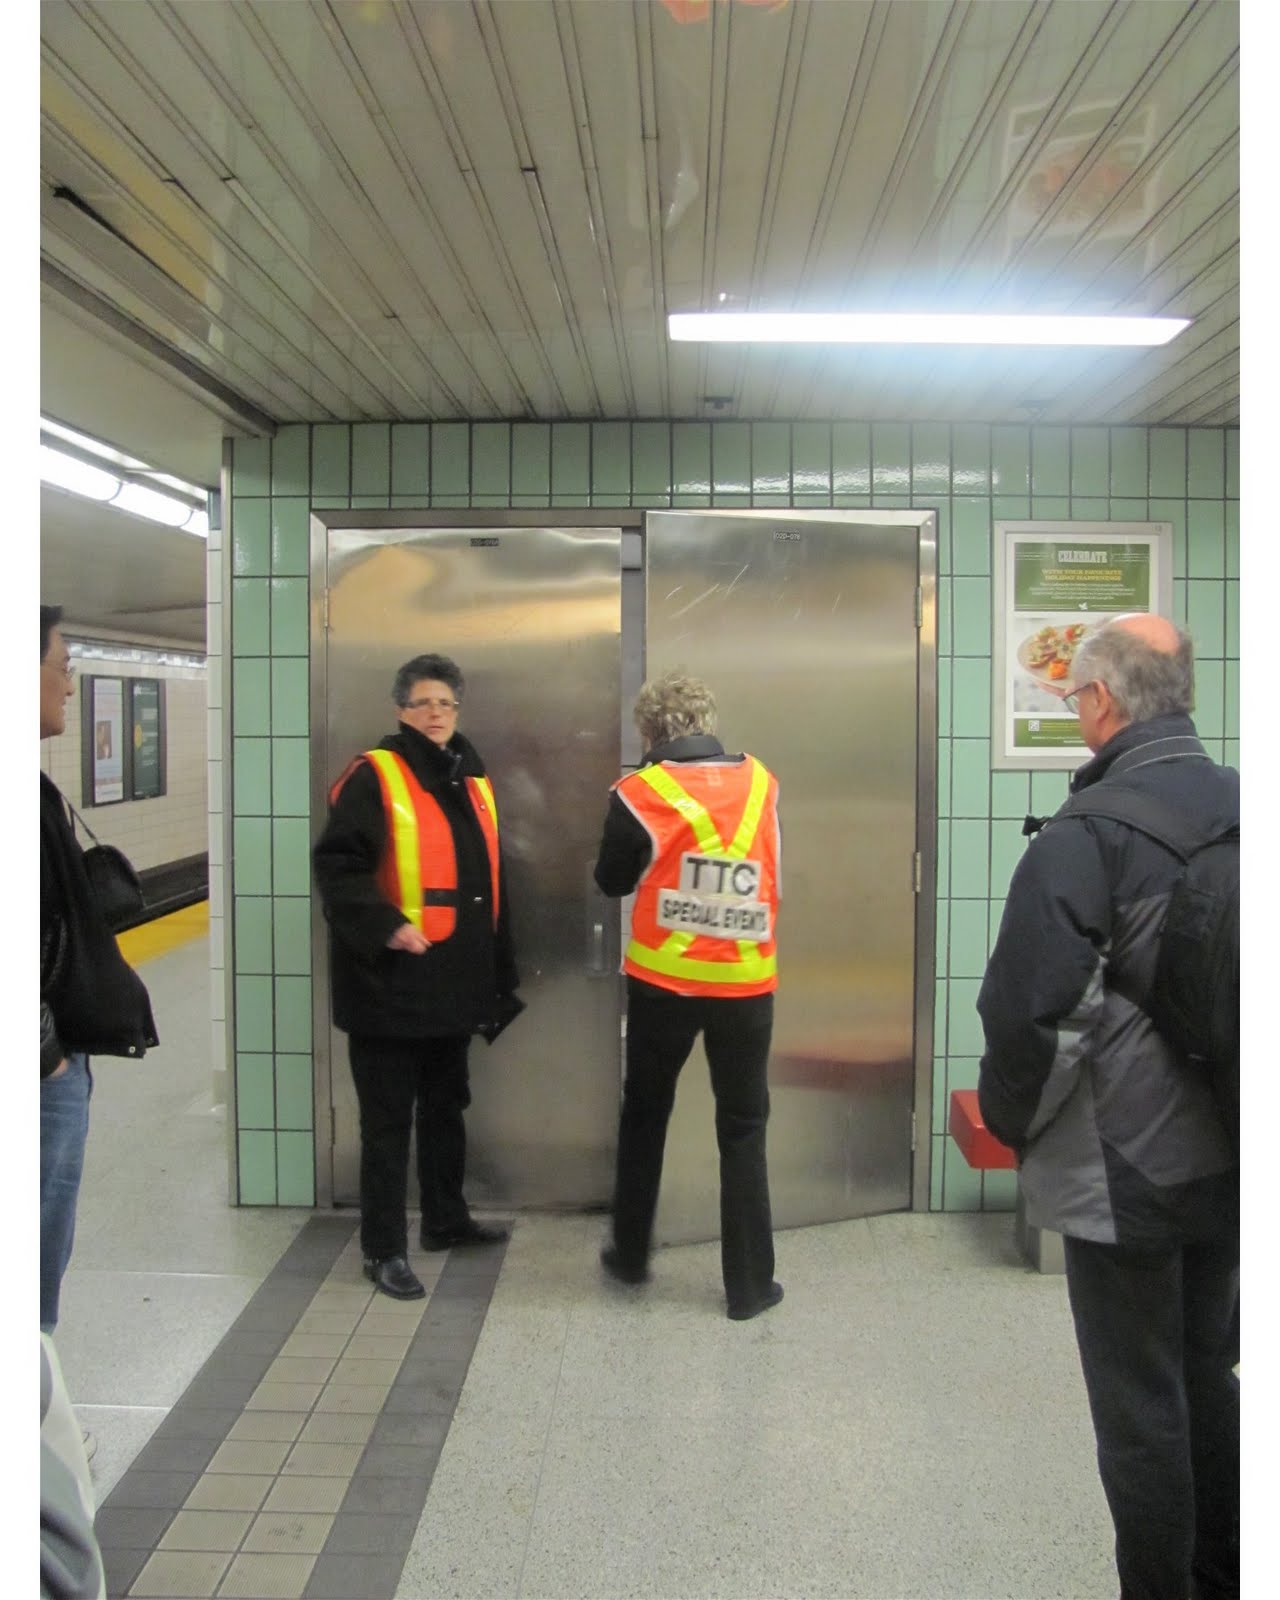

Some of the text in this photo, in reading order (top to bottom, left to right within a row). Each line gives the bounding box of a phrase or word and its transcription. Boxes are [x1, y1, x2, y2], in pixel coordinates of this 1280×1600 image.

[1057, 550, 1108, 563] CELEBRATE
[686, 857, 756, 896] TTC
[663, 899, 719, 927] SPECIAL
